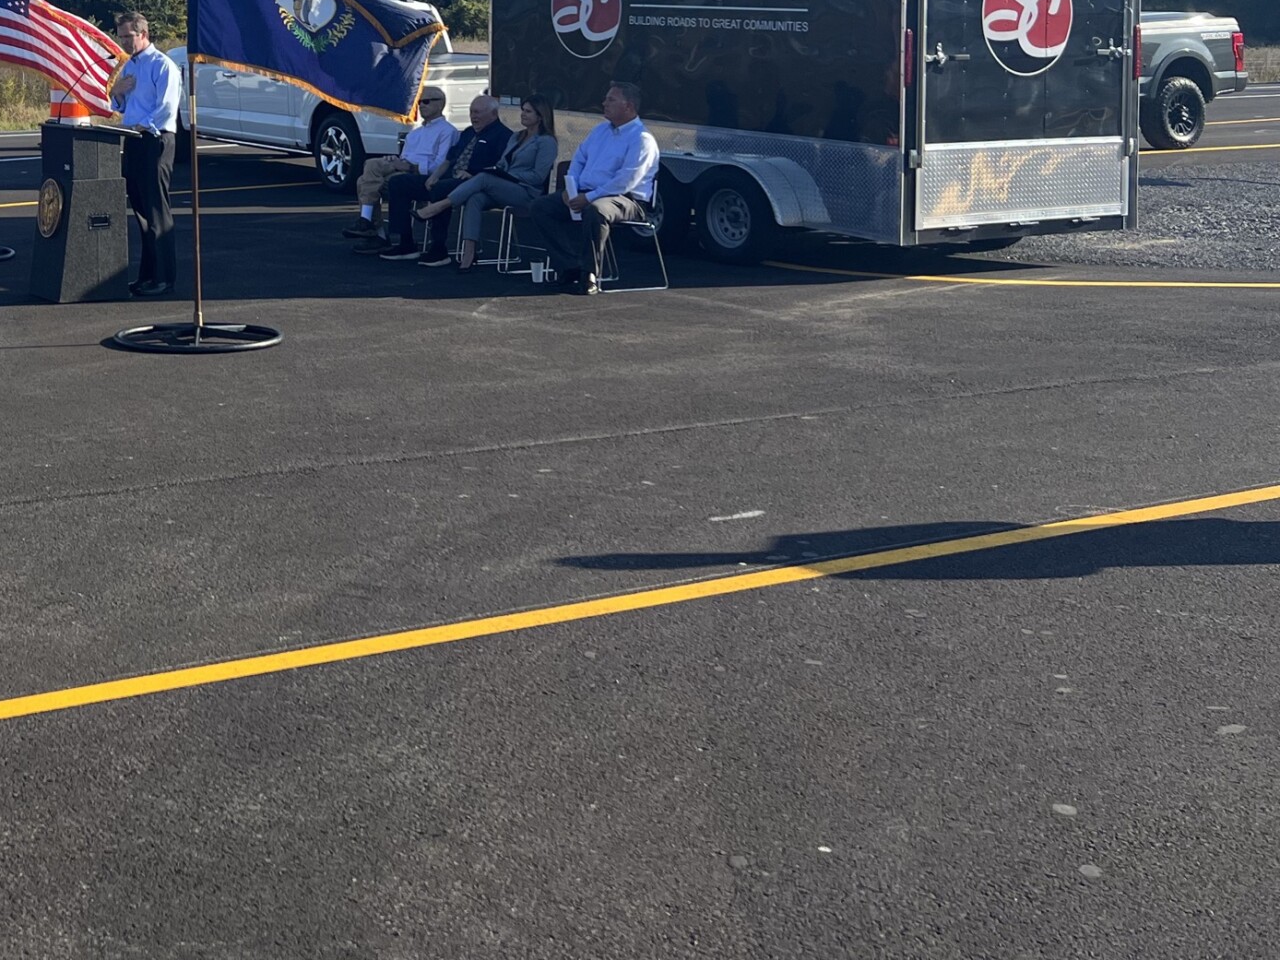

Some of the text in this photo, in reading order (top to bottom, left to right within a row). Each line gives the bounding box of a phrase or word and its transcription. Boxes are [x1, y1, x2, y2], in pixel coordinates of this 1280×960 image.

[628, 15, 809, 32] BUILDING ROADS TO GREAT COMMUNITIES
